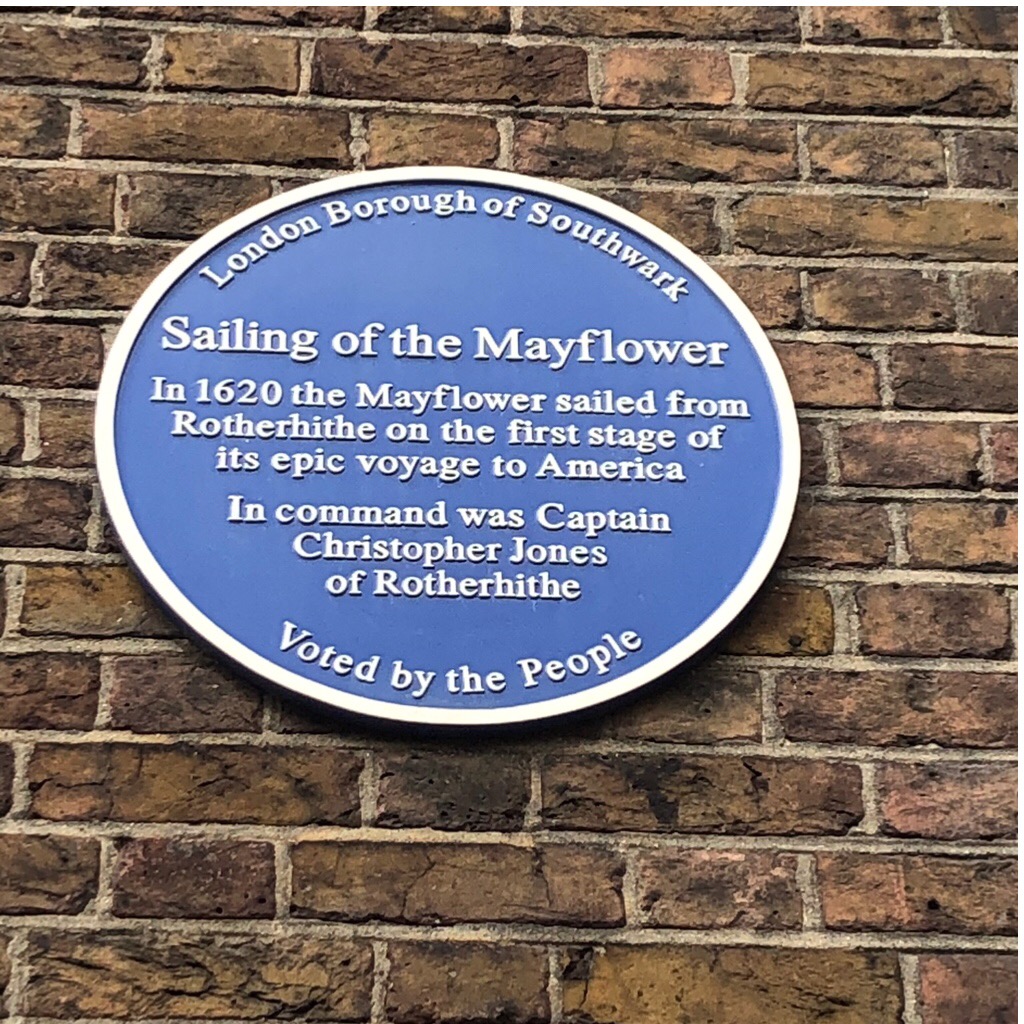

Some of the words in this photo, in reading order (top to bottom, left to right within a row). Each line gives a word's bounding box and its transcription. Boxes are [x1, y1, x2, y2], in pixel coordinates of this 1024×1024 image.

[199, 214, 322, 289] London
[321, 188, 477, 226] Borough
[483, 194, 525, 219] of
[526, 200, 689, 303] Southwark
[162, 315, 319, 362] Sailing
[331, 322, 386, 357] of
[388, 324, 462, 359] the
[472, 326, 729, 370] Mayflower
[149, 376, 187, 403] In
[196, 378, 283, 406] 1620
[290, 381, 346, 408] the
[355, 382, 547, 414] Mayflower
[555, 389, 658, 415] sailed
[666, 389, 751, 418] from
[170, 409, 376, 441] Rotherhithe
[385, 420, 430, 442] on
[441, 419, 496, 444] the
[507, 418, 581, 447] first
[588, 424, 677, 454] stage
[687, 424, 726, 450] of
[215, 445, 260, 471] its
[270, 448, 346, 479] epic
[355, 454, 481, 483] voyage
[491, 455, 527, 478] to
[535, 452, 687, 482] America
[227, 494, 267, 523] In
[275, 501, 449, 527] command
[456, 507, 526, 528] was
[536, 502, 672, 538] Captain
[292, 531, 502, 568] Christopher
[509, 536, 609, 566] Jones
[325, 570, 368, 596] of
[373, 569, 582, 600] Rotherhithe
[279, 620, 381, 683] Voted
[390, 660, 436, 698] by
[446, 665, 507, 694] the
[516, 629, 642, 688] People
